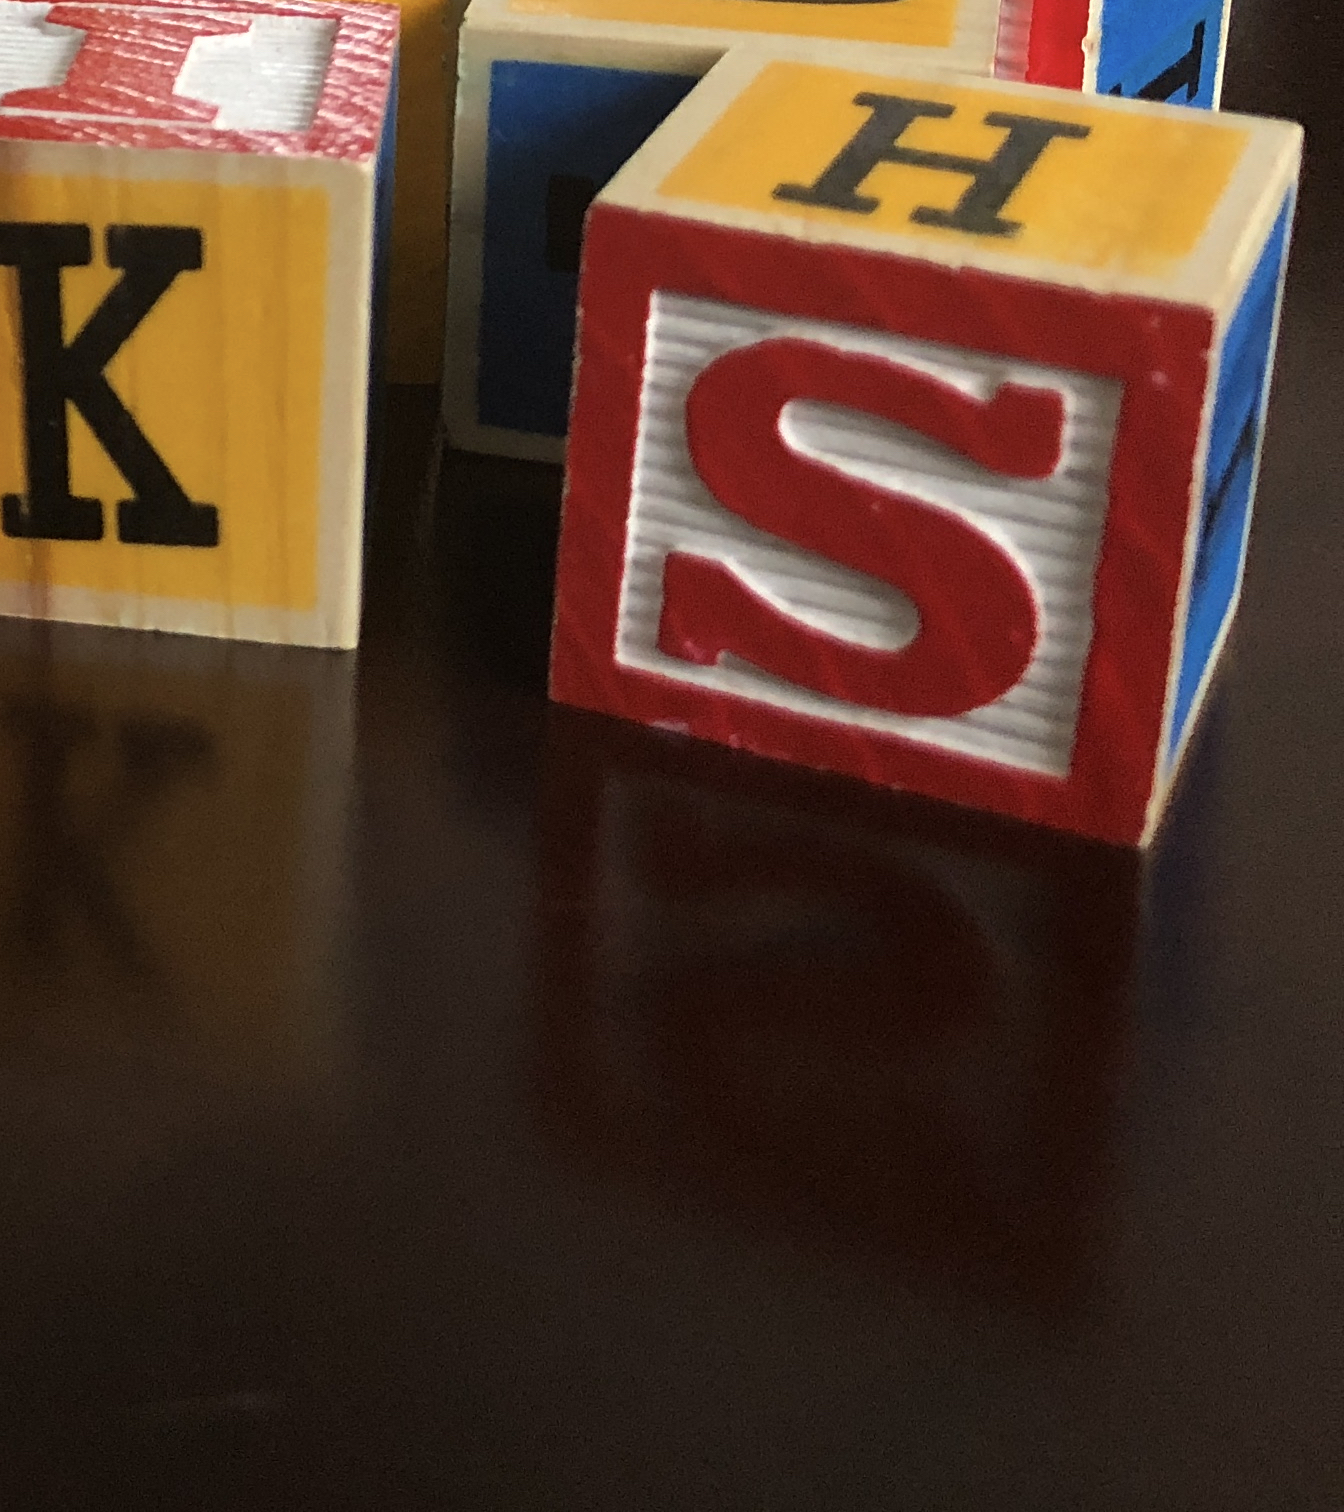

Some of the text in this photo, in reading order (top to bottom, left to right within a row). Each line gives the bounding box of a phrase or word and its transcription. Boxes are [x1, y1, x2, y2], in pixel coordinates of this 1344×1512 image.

[0, 3, 253, 122] I
[771, 90, 1090, 239] H
[655, 336, 1065, 719] S
